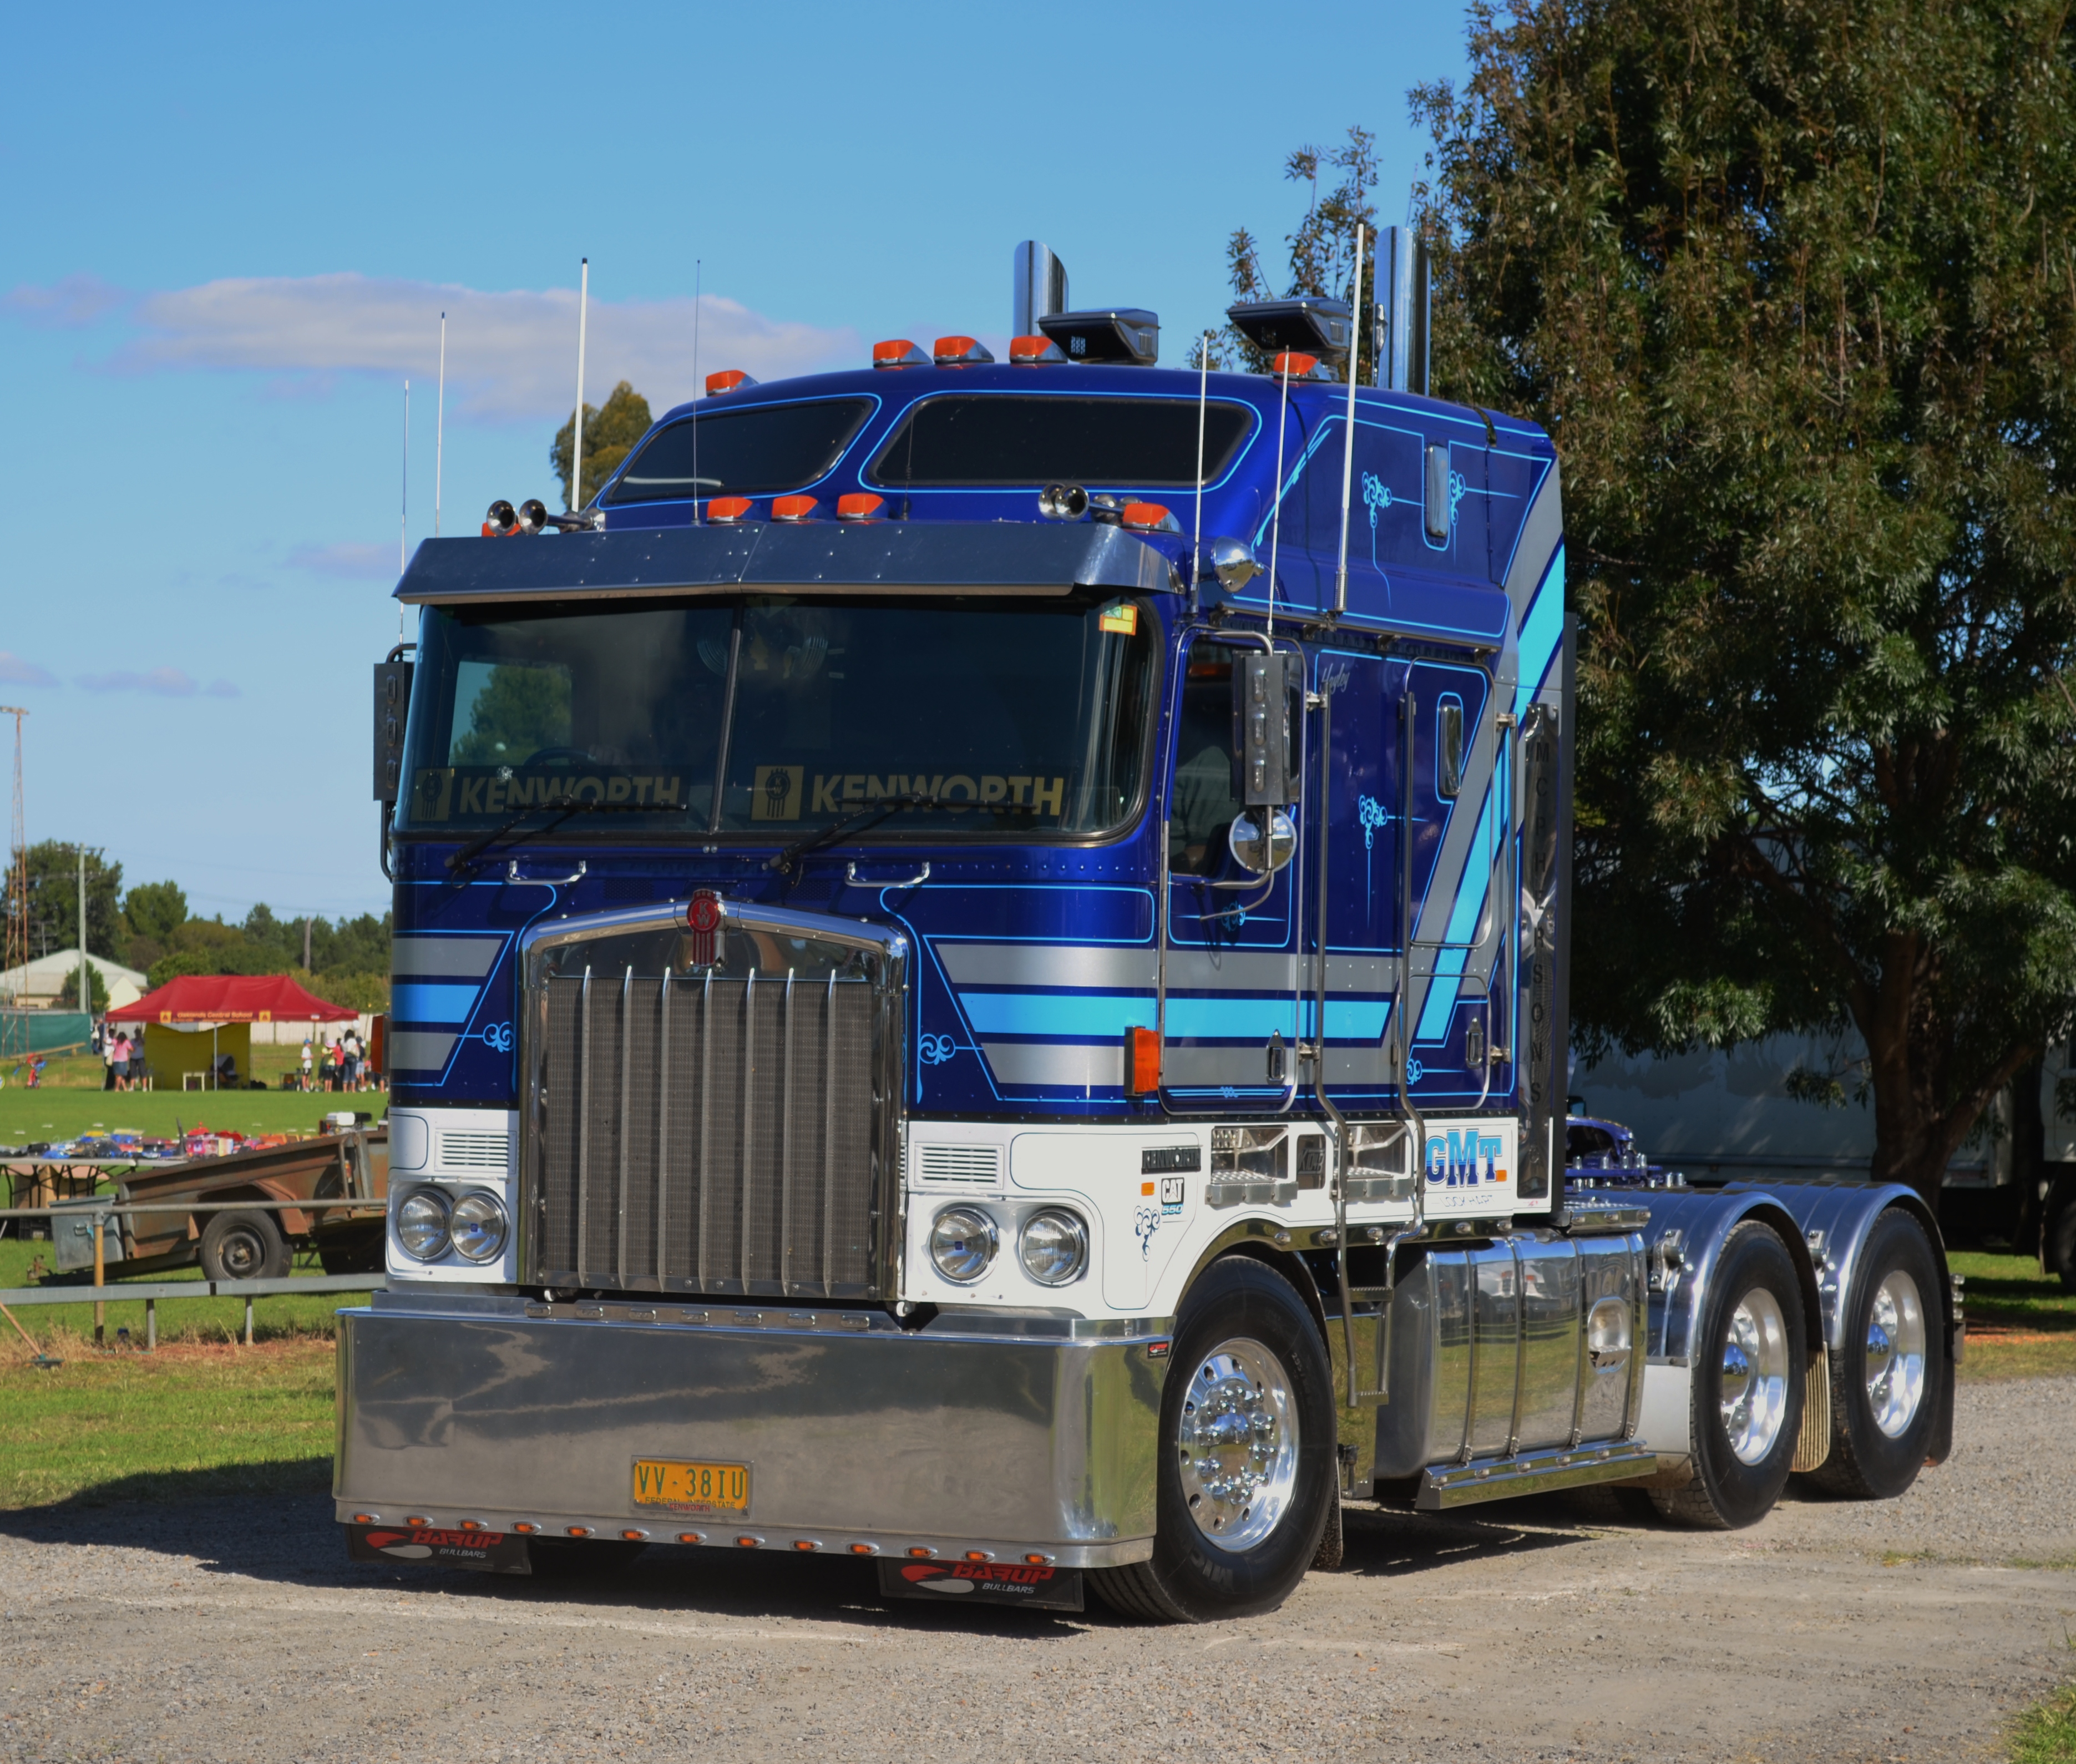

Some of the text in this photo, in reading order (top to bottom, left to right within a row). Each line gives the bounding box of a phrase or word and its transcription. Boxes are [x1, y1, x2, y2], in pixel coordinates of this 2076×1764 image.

[459, 776, 680, 814] KENWORTH
[812, 775, 1064, 816] KENWORTH
[1142, 1148, 1201, 1169] KENWORTH
[1425, 1128, 1503, 1189] GMT
[1162, 1178, 1184, 1203] CAT
[1161, 1204, 1184, 1216] 550
[669, 1503, 711, 1512] KENWORTH
[439, 1548, 487, 1559] BULLBARS
[981, 1582, 1036, 1594] BULLBARS
